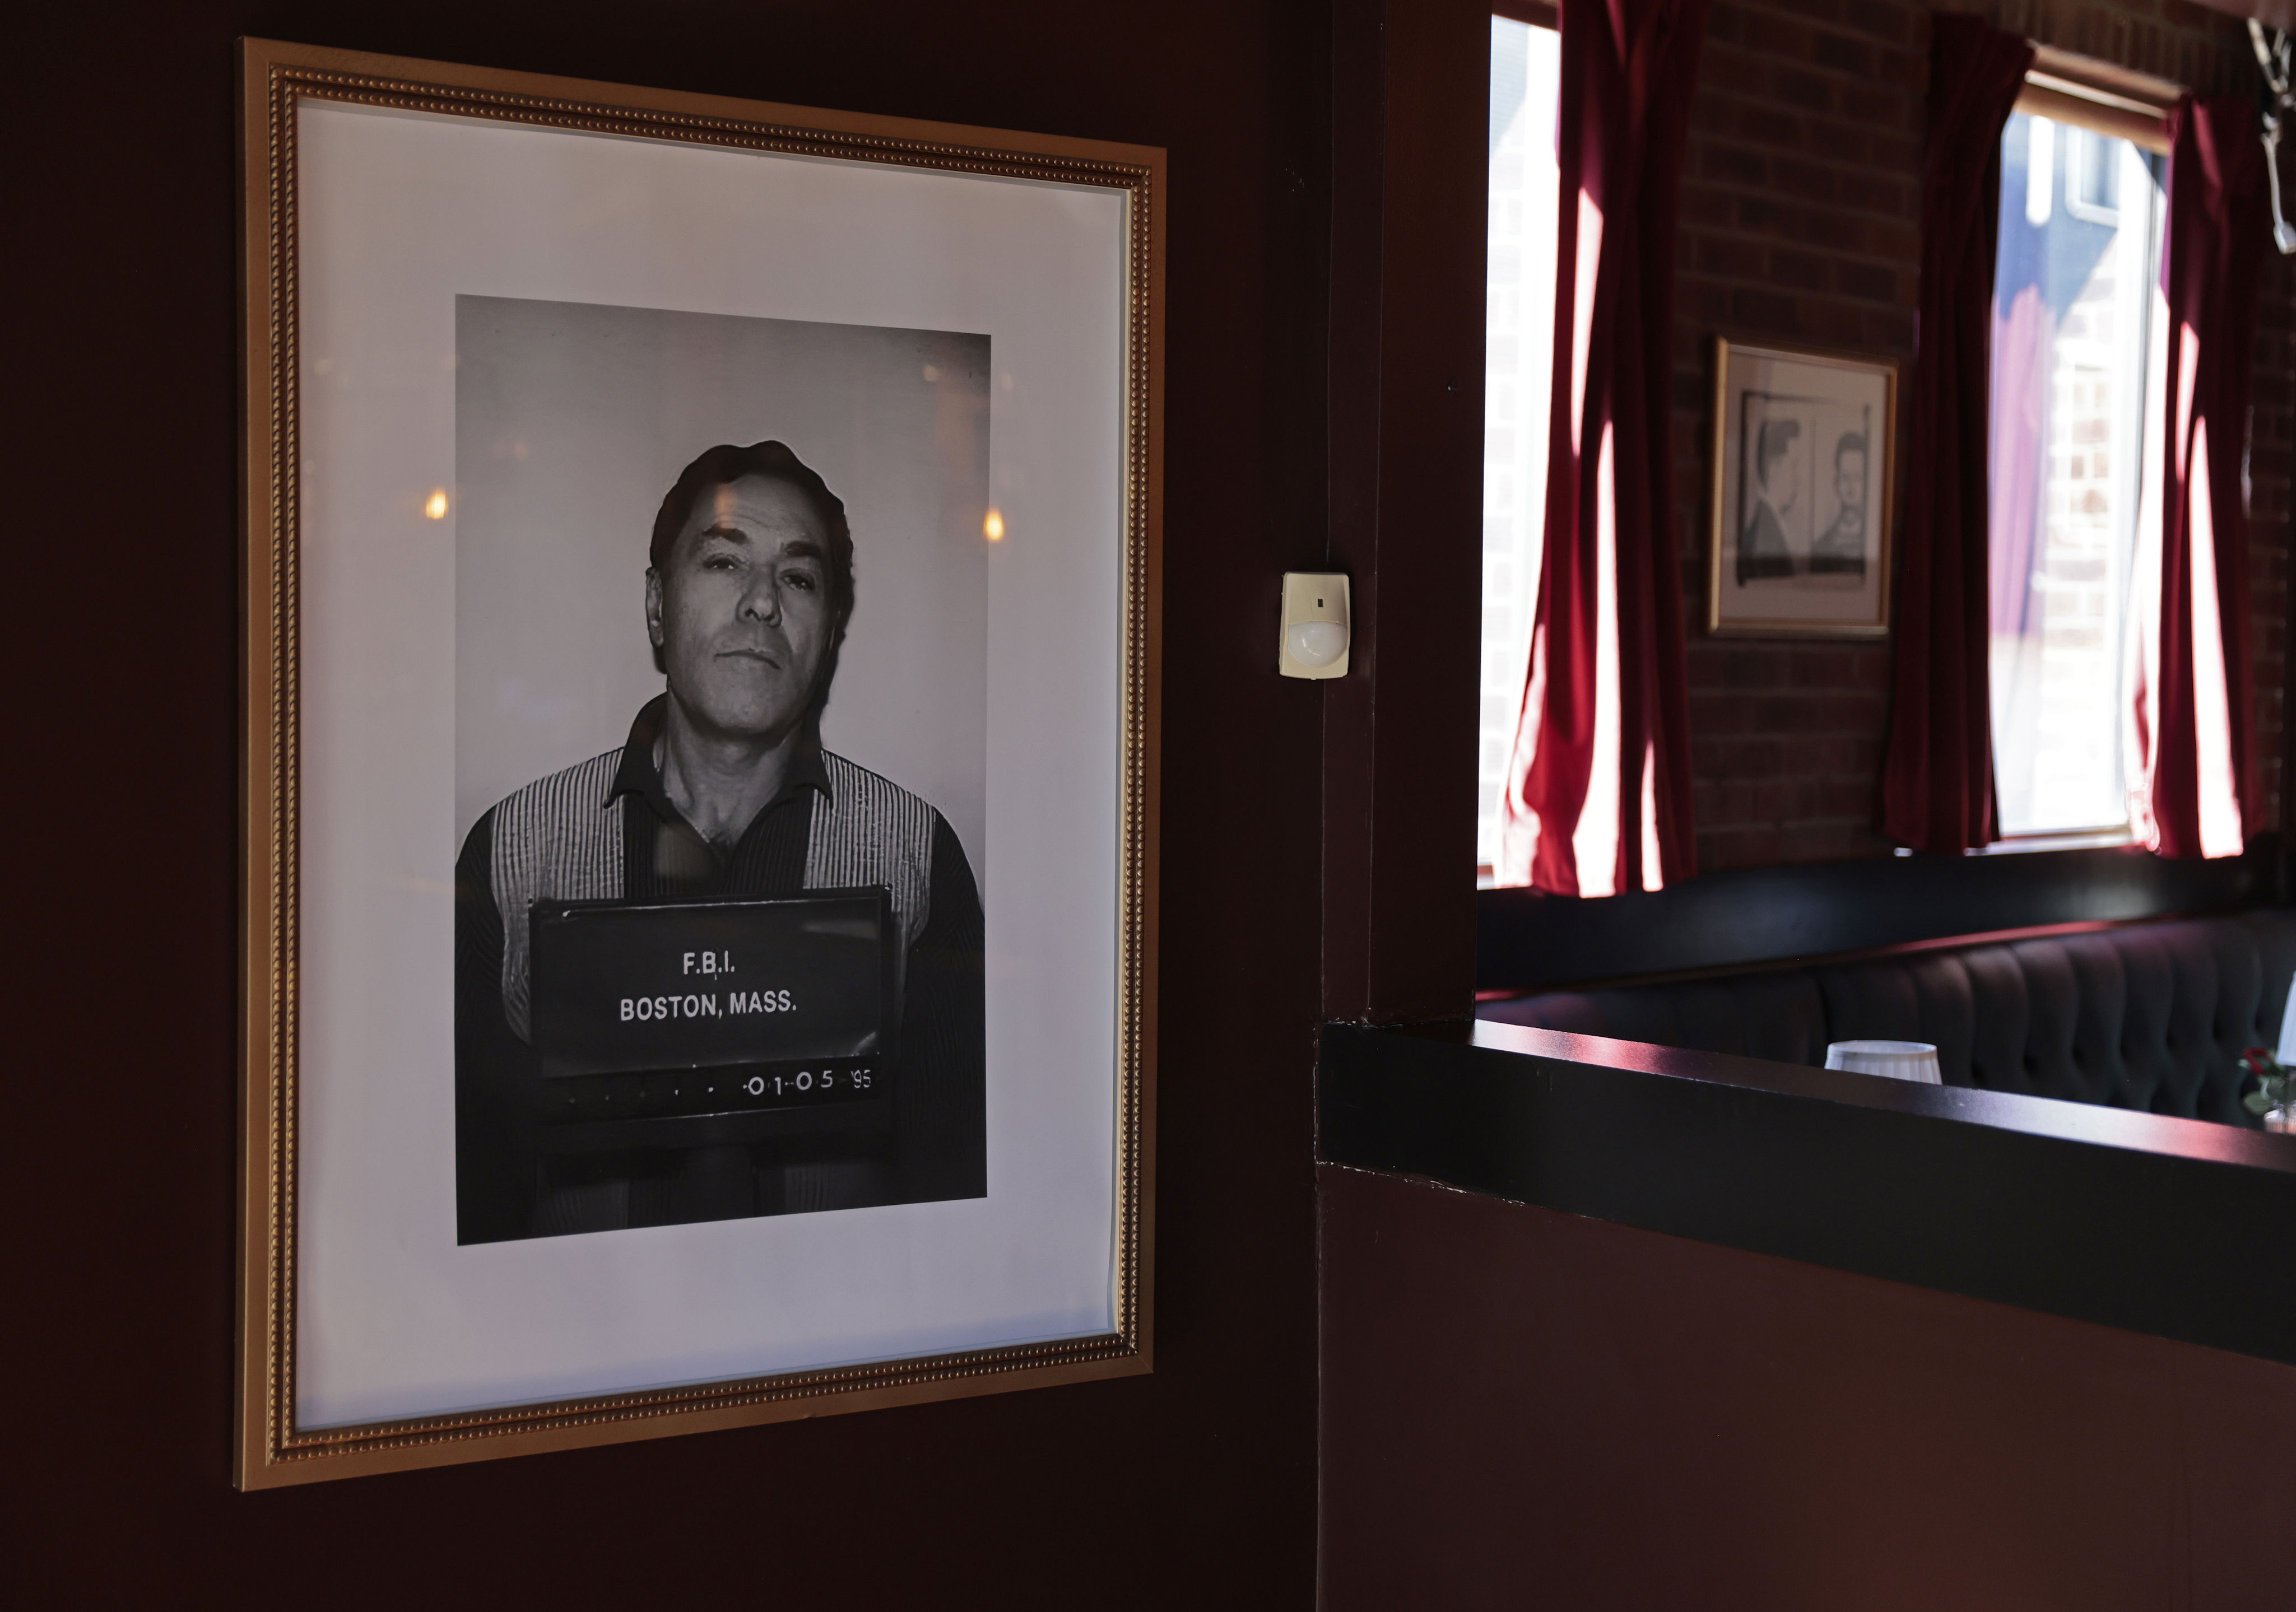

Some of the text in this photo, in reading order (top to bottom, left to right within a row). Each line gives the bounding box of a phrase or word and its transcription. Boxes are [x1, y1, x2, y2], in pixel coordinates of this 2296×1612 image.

[682, 951, 735, 975] F.B.I.
[620, 990, 797, 1021] BOSTON, MASS.
